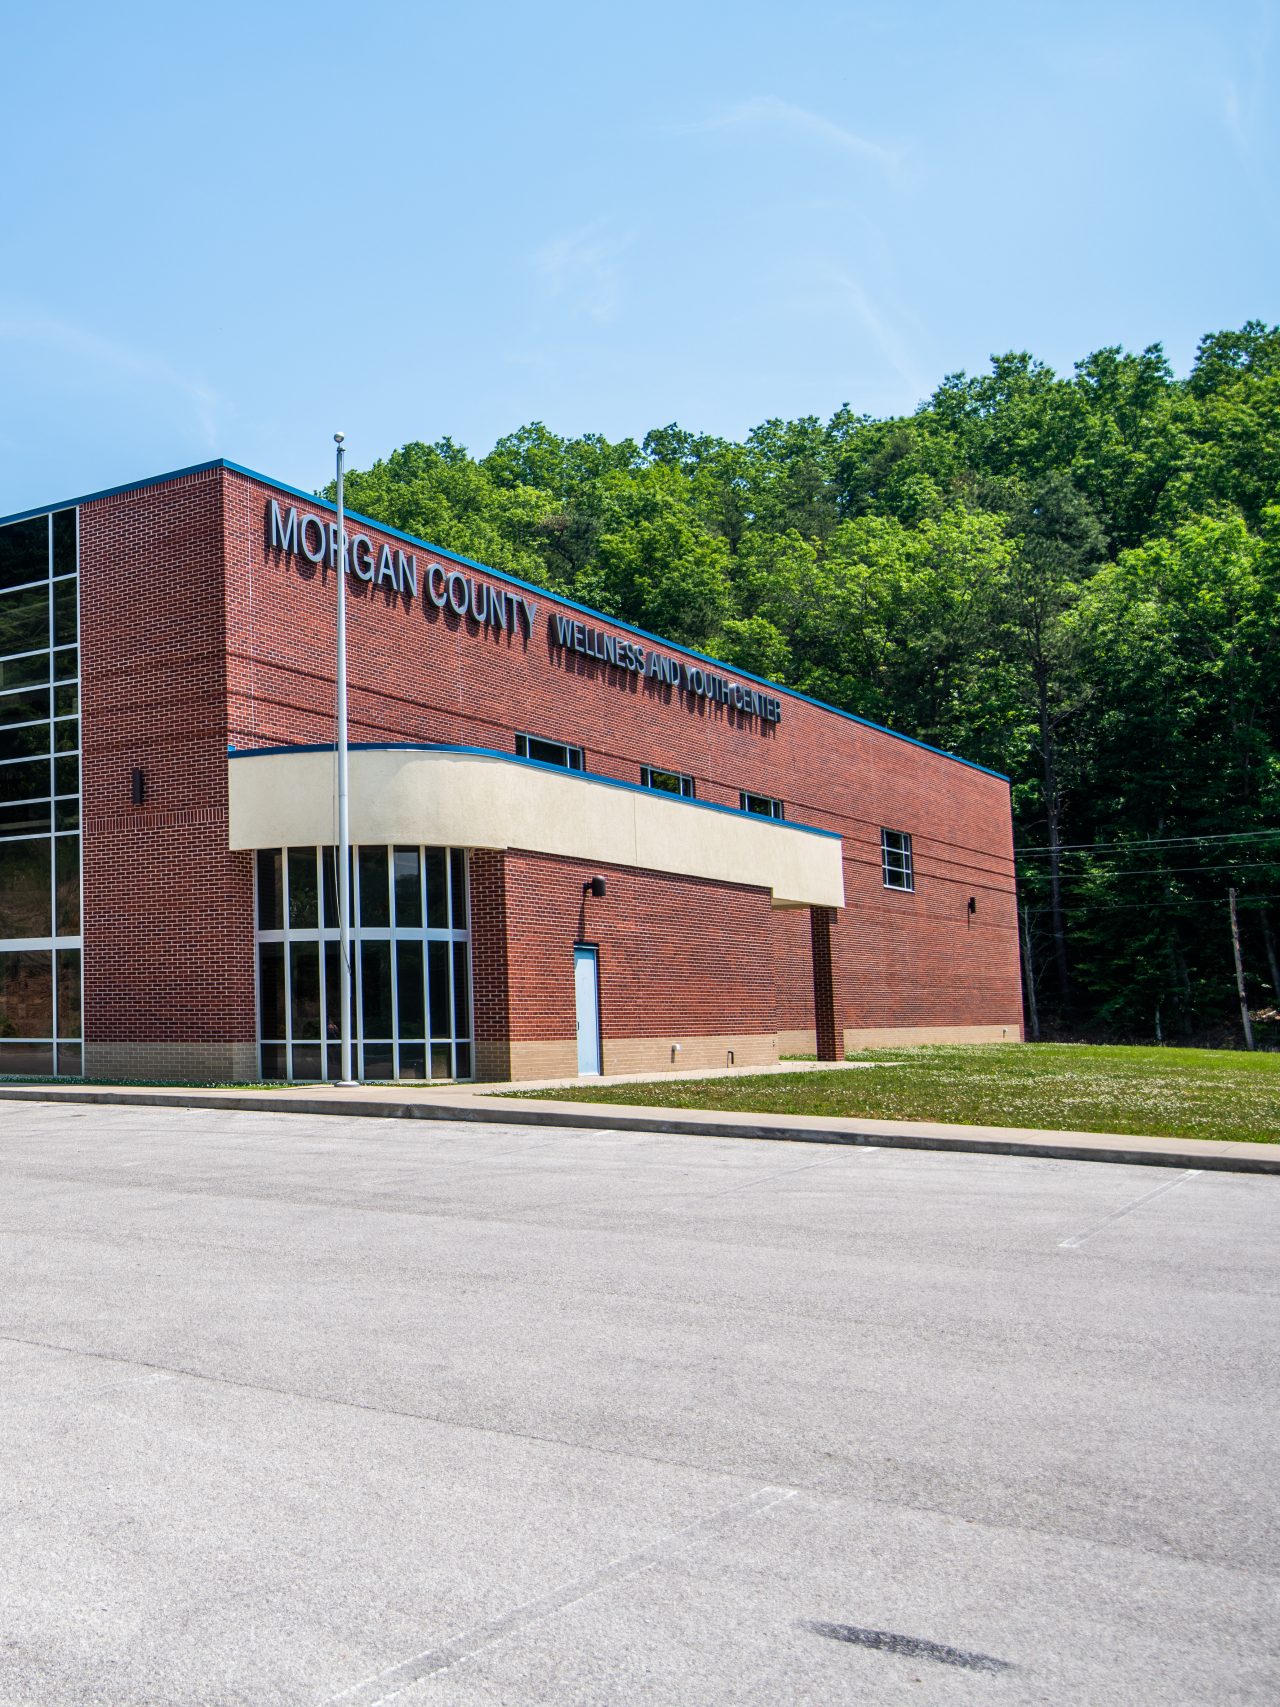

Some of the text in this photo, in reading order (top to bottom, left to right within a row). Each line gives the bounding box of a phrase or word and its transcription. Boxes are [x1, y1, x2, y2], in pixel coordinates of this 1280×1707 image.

[267, 499, 781, 722] MORGAN COUNTY WELLNESS AND YOUTH CENTER
